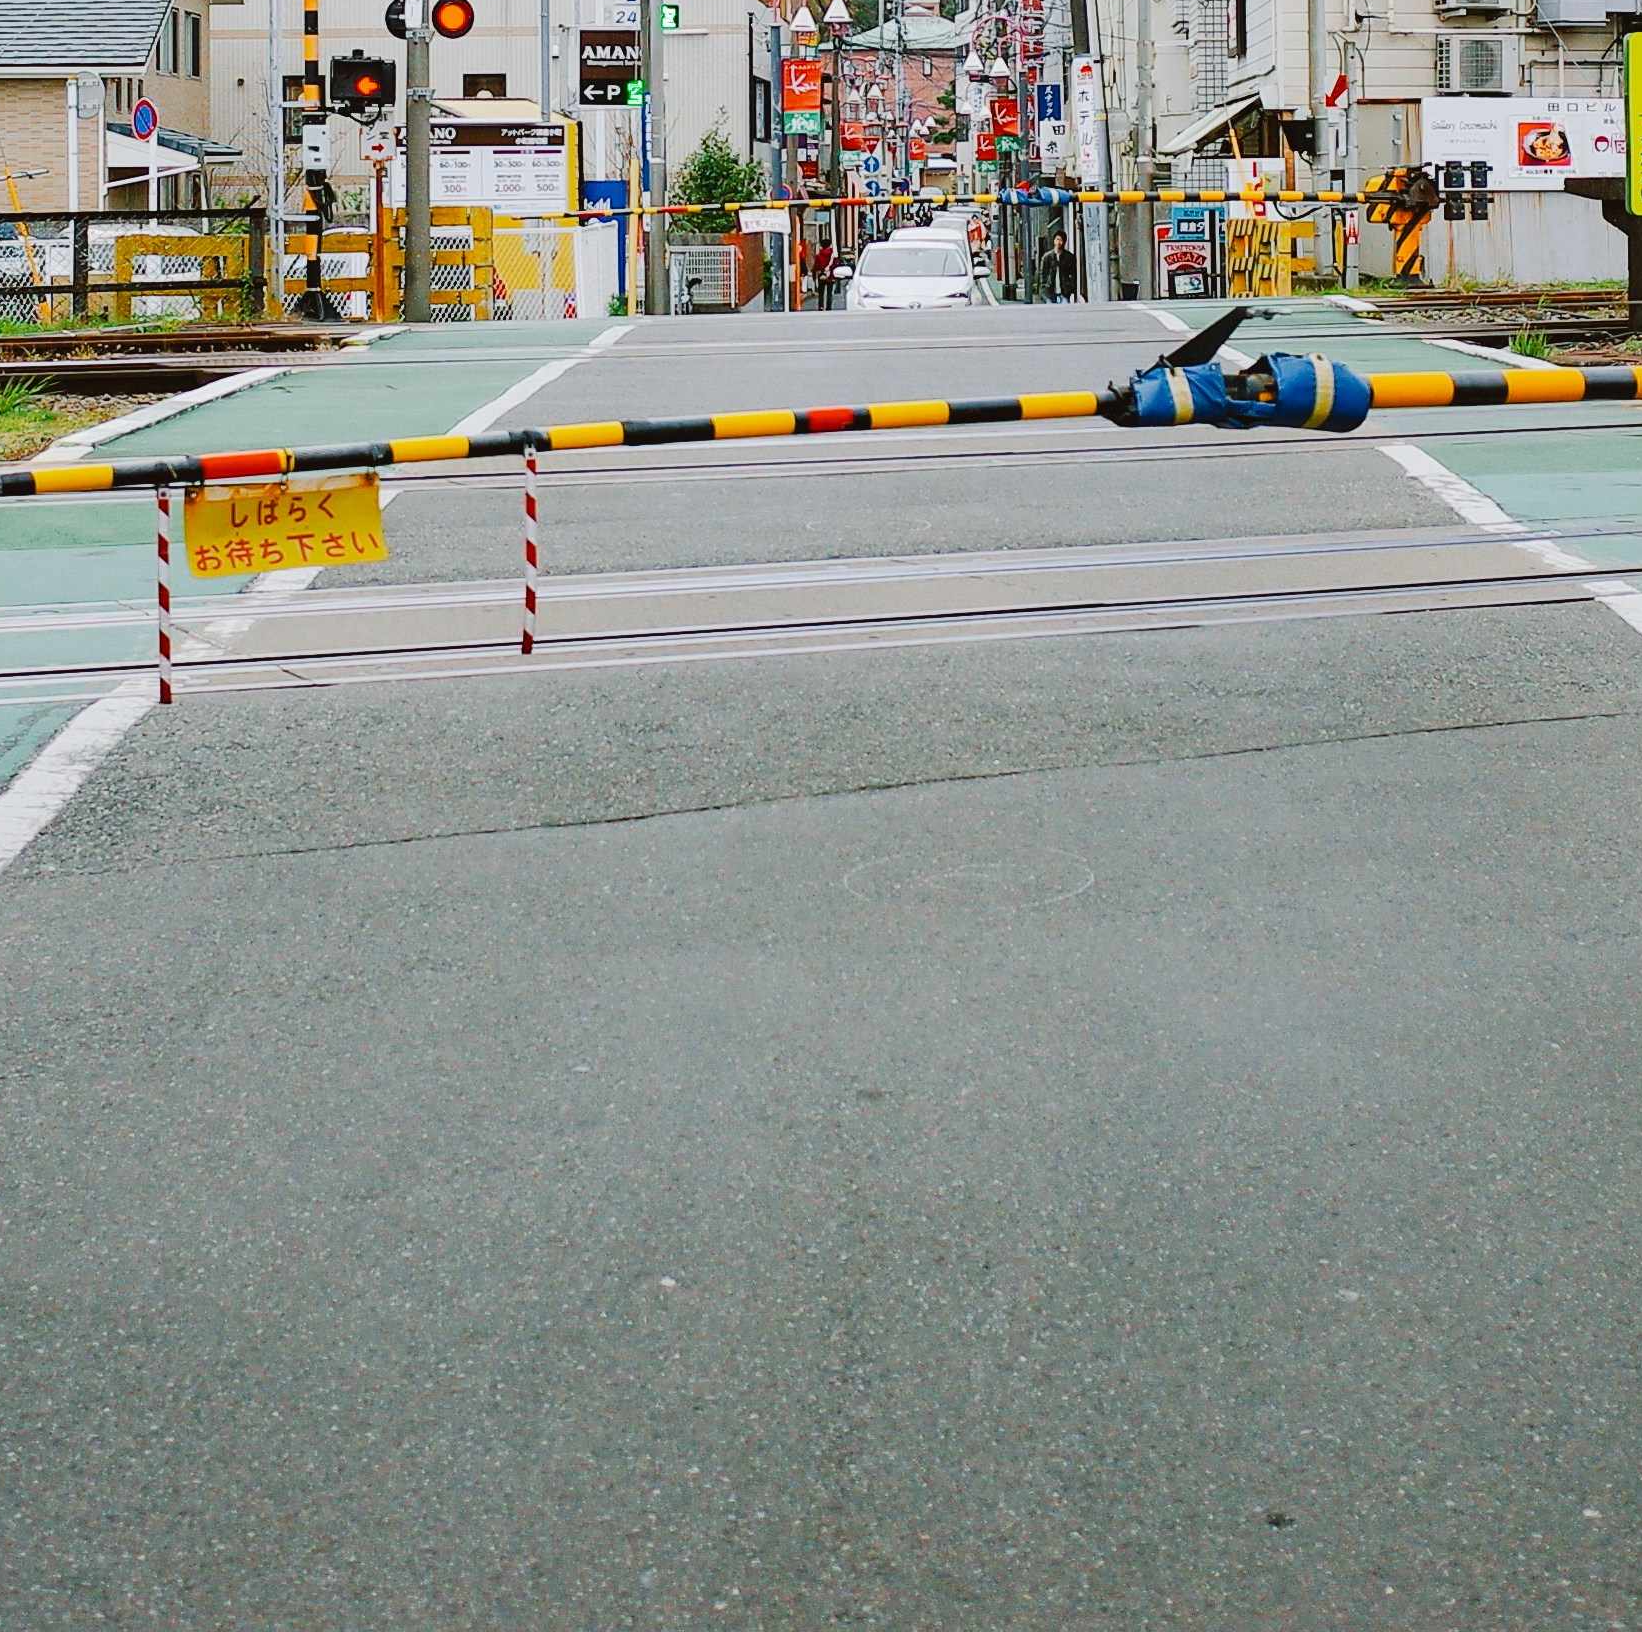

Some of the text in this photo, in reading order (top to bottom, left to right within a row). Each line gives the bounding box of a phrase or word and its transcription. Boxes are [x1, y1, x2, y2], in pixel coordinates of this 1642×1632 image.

[581, 45, 643, 61] AMAN
[607, 84, 621, 101] P
[1077, 88, 1094, 147] ホテル
[1165, 252, 1205, 265] RISATA
[230, 492, 335, 528] しばらく
[194, 531, 380, 572] お待ち下さい
